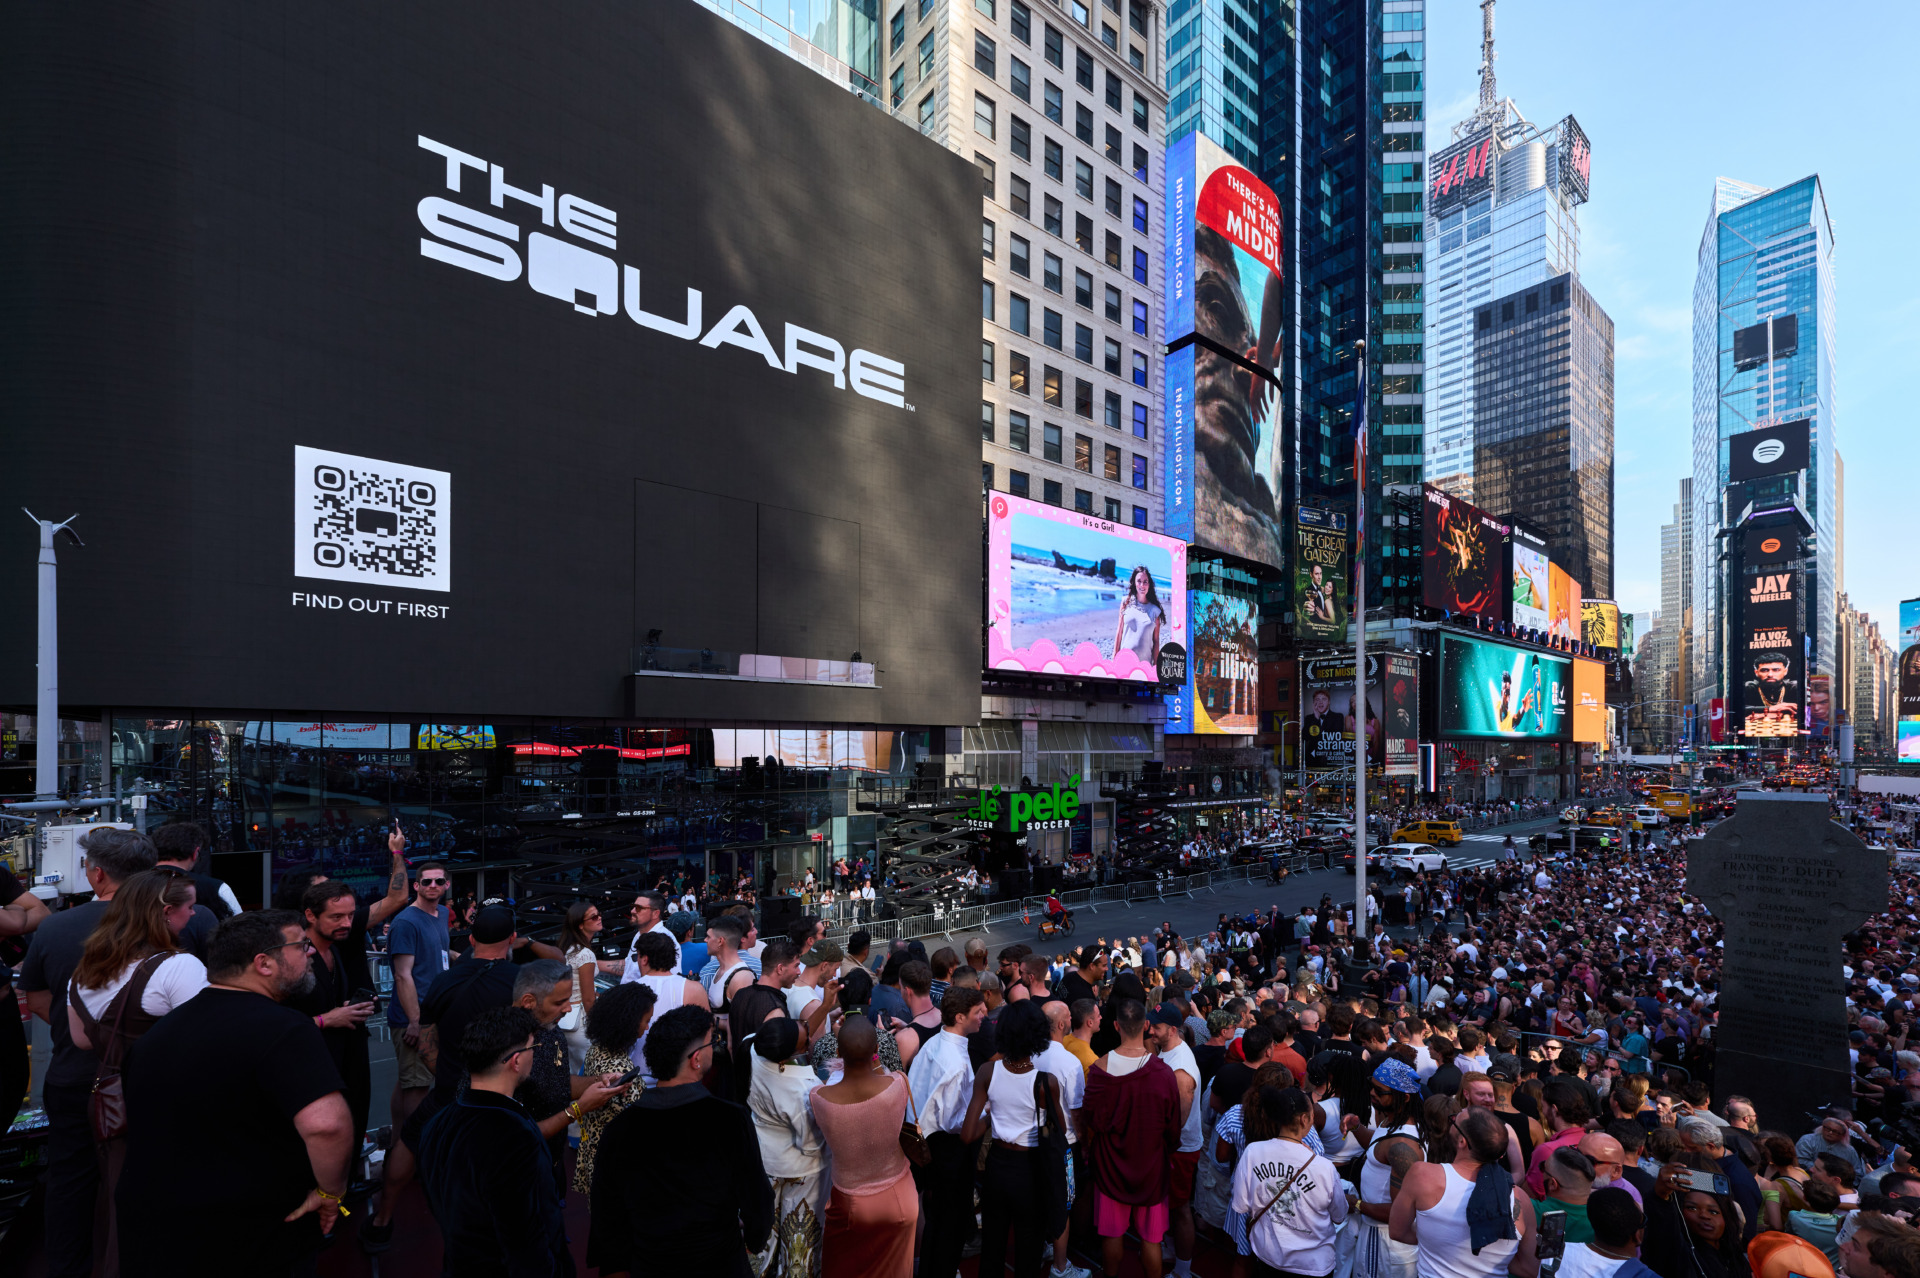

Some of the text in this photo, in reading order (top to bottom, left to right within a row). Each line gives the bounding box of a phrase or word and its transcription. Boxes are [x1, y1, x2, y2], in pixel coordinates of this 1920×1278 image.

[1432, 138, 1491, 199] H&M
[418, 134, 617, 250] THE
[1226, 171, 1265, 212] THERE'S
[1242, 200, 1278, 243] IN THE
[1175, 176, 1183, 300] ENJOYILLINOIS.COM
[1226, 209, 1284, 277] MIDDLE
[417, 196, 905, 409] SQUARE
[1082, 516, 1093, 527] It's
[1101, 521, 1115, 533] Girl!
[1299, 531, 1346, 552] THE GREAT
[1303, 547, 1341, 565] GATSBY
[1750, 574, 1791, 595] JAY
[1750, 591, 1792, 603] WHEELER
[292, 592, 450, 619] FIND OUT FIRST
[1754, 630, 1788, 641] LA VOZ
[1220, 640, 1240, 653] enjoy
[1749, 638, 1792, 650] FAVORITA
[1161, 666, 1185, 679] SQUARE
[1316, 668, 1334, 678] BEST
[1321, 730, 1342, 741] two
[1317, 740, 1369, 753] stranges
[1010, 773, 1081, 833] pelé
[963, 818, 993, 829] OCCER
[1026, 819, 1070, 831] SOCCER
[1730, 853, 1835, 868] LIEUTENANT COLONEL
[44, 874, 60, 883] NYPD
[333, 867, 374, 876] GLOBAL
[1723, 861, 1777, 874] FRANCIS
[1796, 866, 1845, 880] DUFFY
[1737, 884, 1828, 898] CATHOLIC PRIEST
[1758, 903, 1806, 914] CHAPLAIN
[1748, 937, 1768, 946] LIFE
[1771, 940, 1785, 948] OF
[1788, 943, 1829, 954] SERVICE
[1734, 949, 1832, 968] GOD AND COUNTRY
[1766, 971, 1811, 983] AMERICAN
